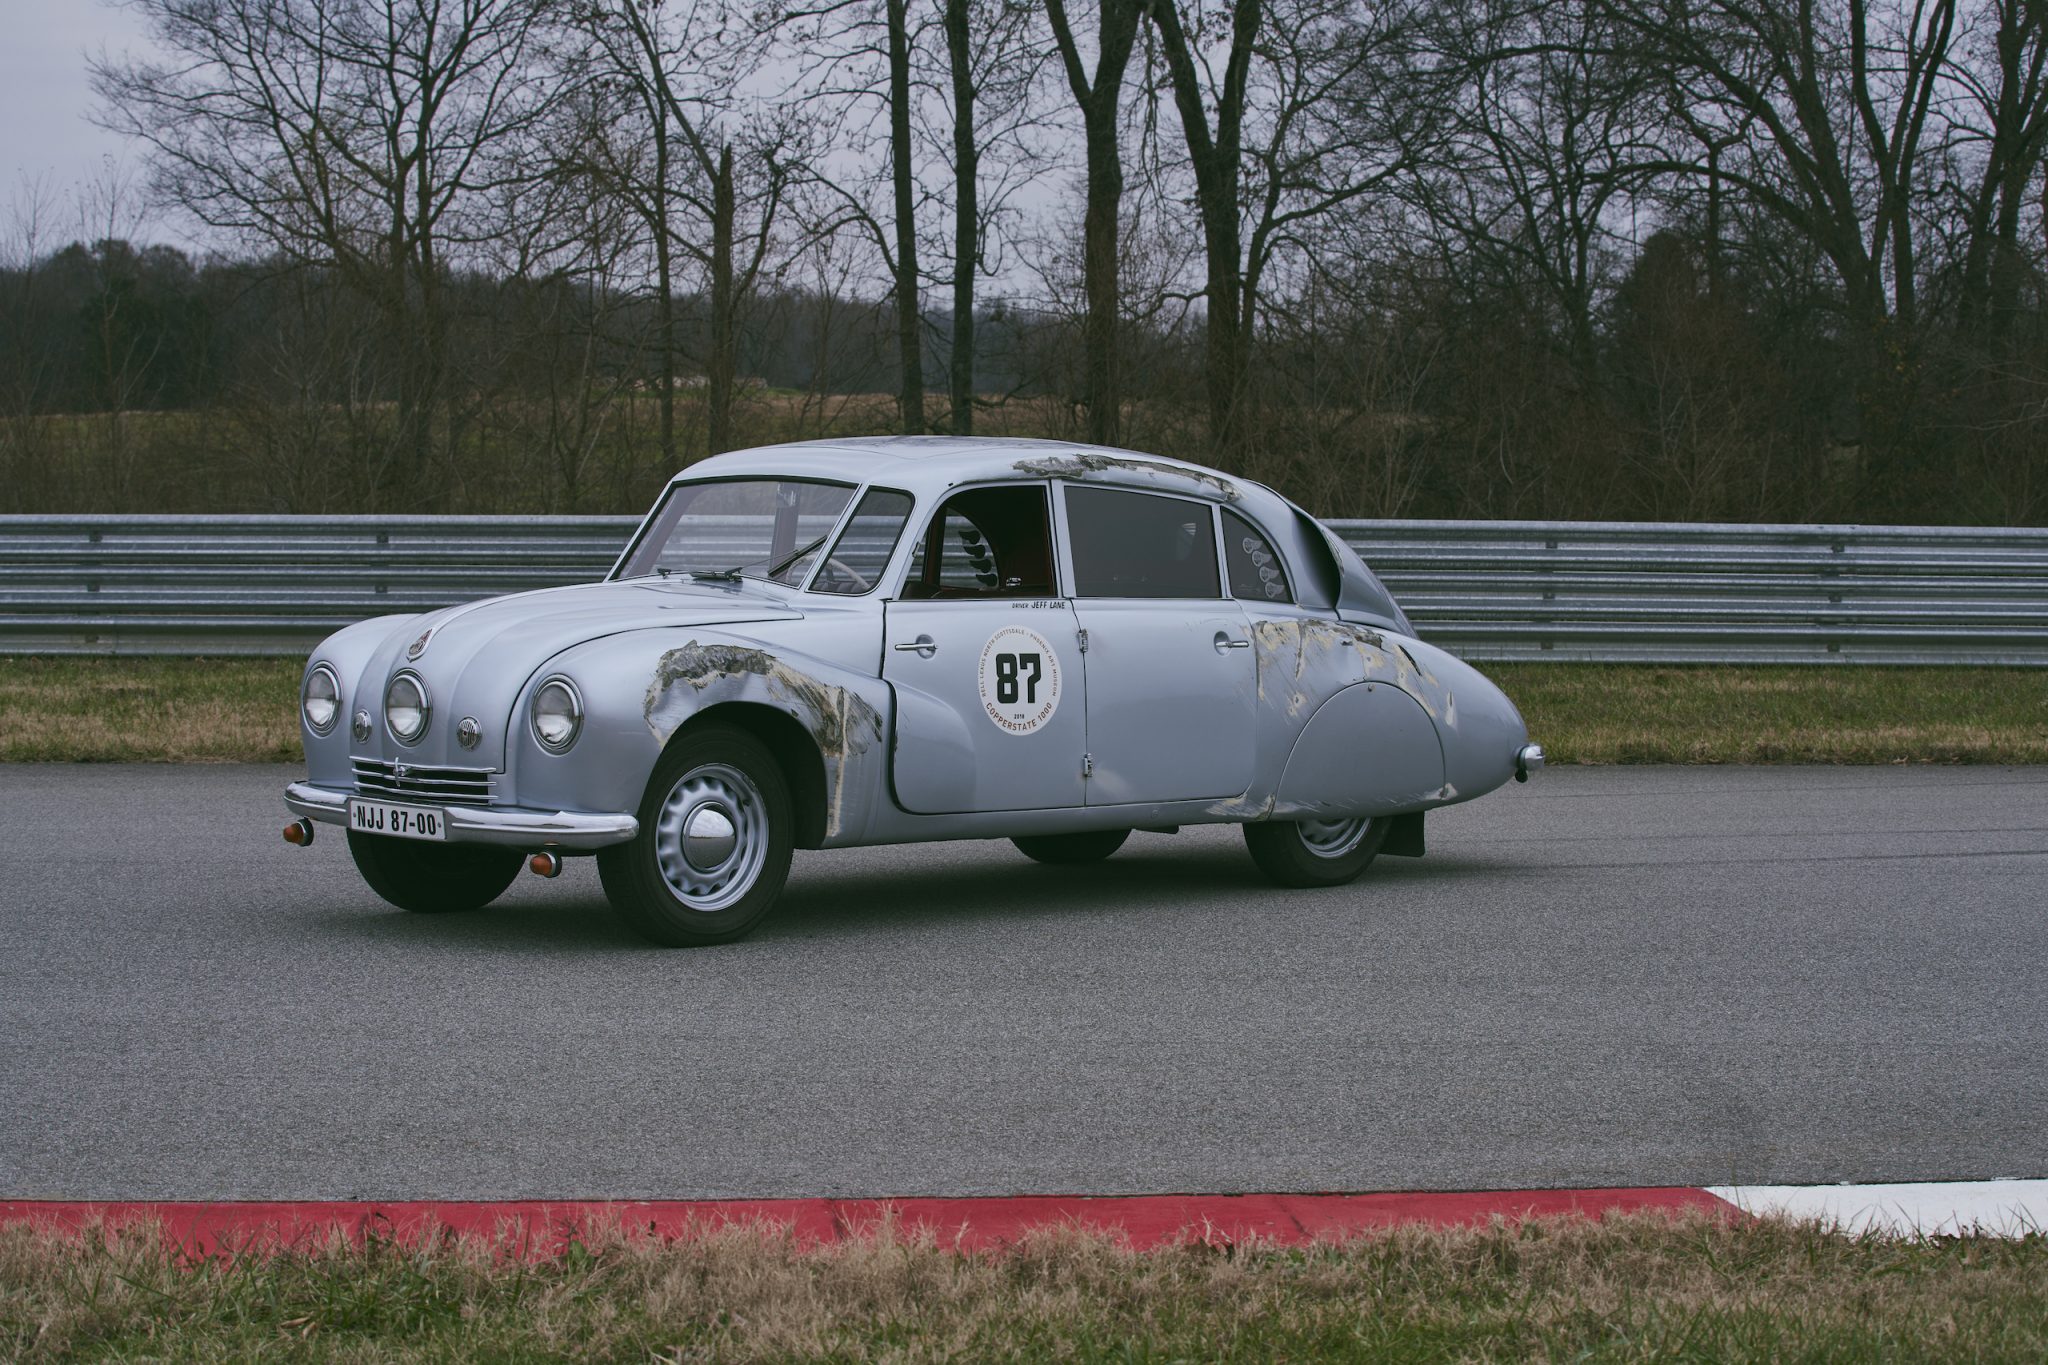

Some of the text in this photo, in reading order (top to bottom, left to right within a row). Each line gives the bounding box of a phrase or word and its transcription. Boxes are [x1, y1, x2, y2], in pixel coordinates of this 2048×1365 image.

[1050, 601, 1066, 609] LANE
[984, 638, 995, 657] NORTH
[995, 628, 1025, 640] SCOTTSDALE
[996, 653, 1042, 704] 87
[986, 702, 1052, 731] COPPERSTATE 1000
[358, 806, 436, 836] NJJ 87-00
